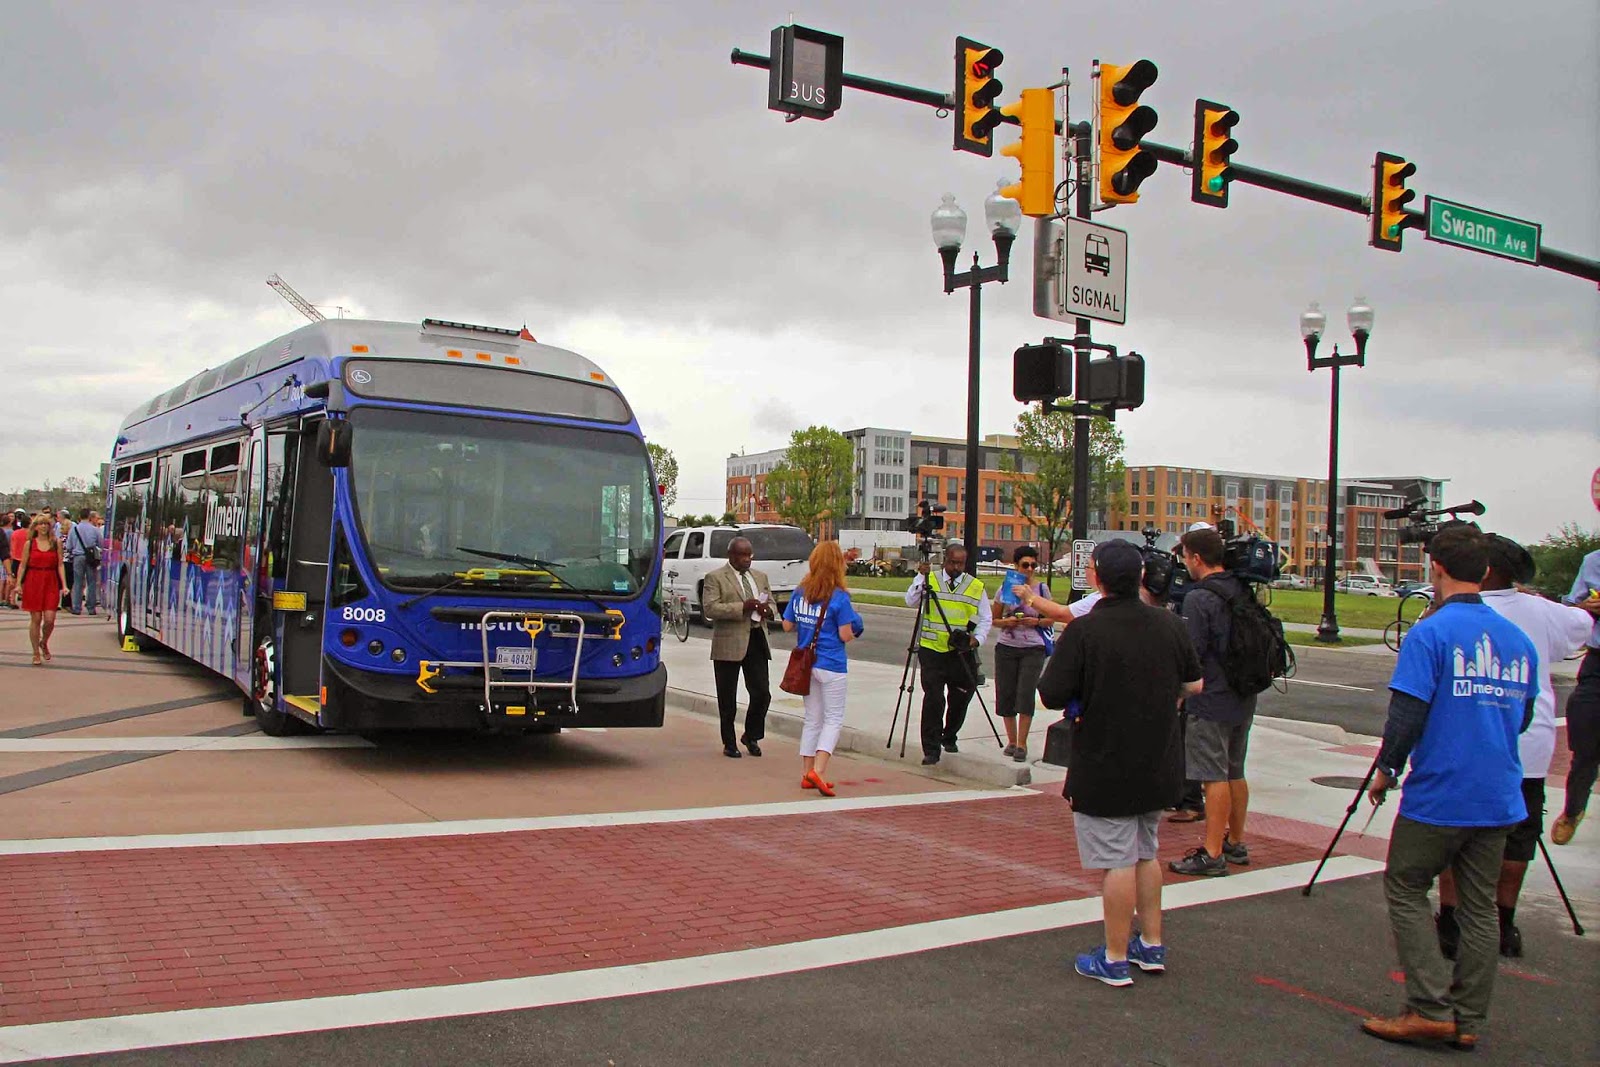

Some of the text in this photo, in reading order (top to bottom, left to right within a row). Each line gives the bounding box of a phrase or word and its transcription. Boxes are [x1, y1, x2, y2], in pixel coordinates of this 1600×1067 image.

[790, 80, 826, 105] BUS
[1441, 209, 1527, 253] Swann Ave
[1072, 285, 1120, 312] SIGNAL
[342, 606, 386, 623] 8008
